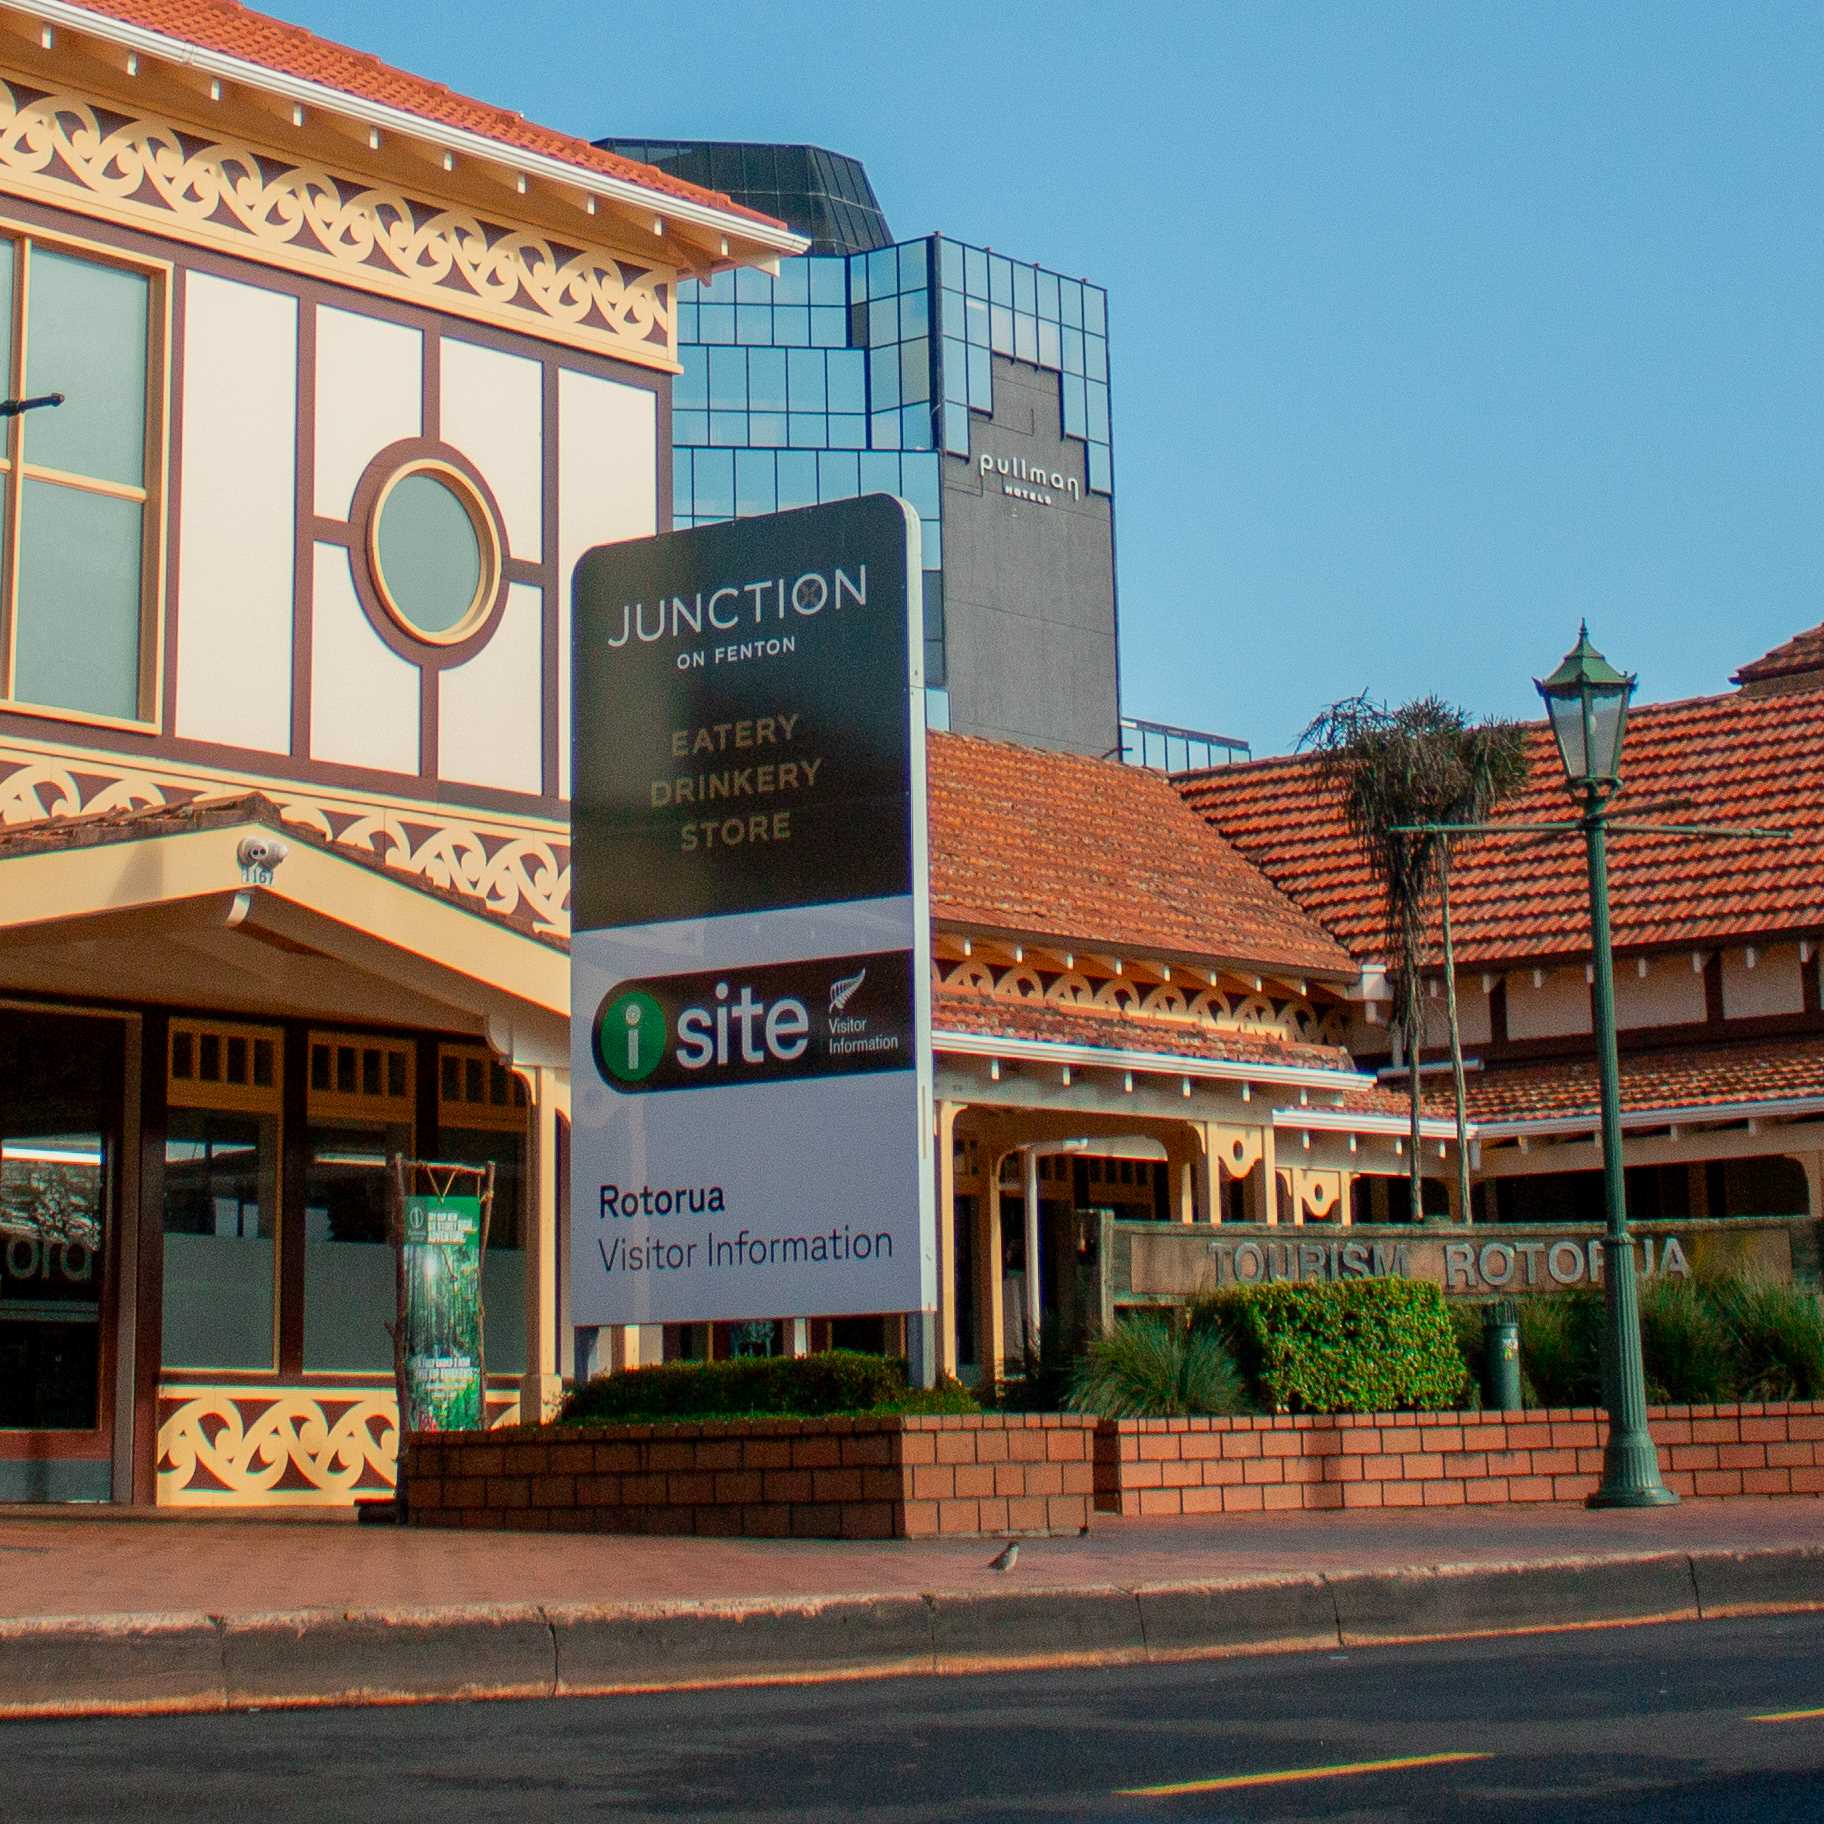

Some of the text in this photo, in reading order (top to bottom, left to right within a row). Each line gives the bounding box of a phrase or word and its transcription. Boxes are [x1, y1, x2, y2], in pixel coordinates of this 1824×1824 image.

[980, 454, 1079, 501] pullman
[1005, 486, 1052, 505] HOTELS
[607, 564, 867, 648] JUNCTION
[677, 636, 796, 670] ON FENTON
[670, 712, 800, 758] EATERY
[649, 759, 823, 809] DRINKERY
[680, 812, 793, 852] STORE
[675, 982, 809, 1070] site
[829, 1016, 867, 1035] Visitor
[829, 1035, 898, 1055] Information
[598, 1184, 725, 1220] Rotorua
[6, 1240, 93, 1280] ora
[598, 1224, 894, 1274] Visitor Information
[1208, 1241, 1408, 1287] TOURISM
